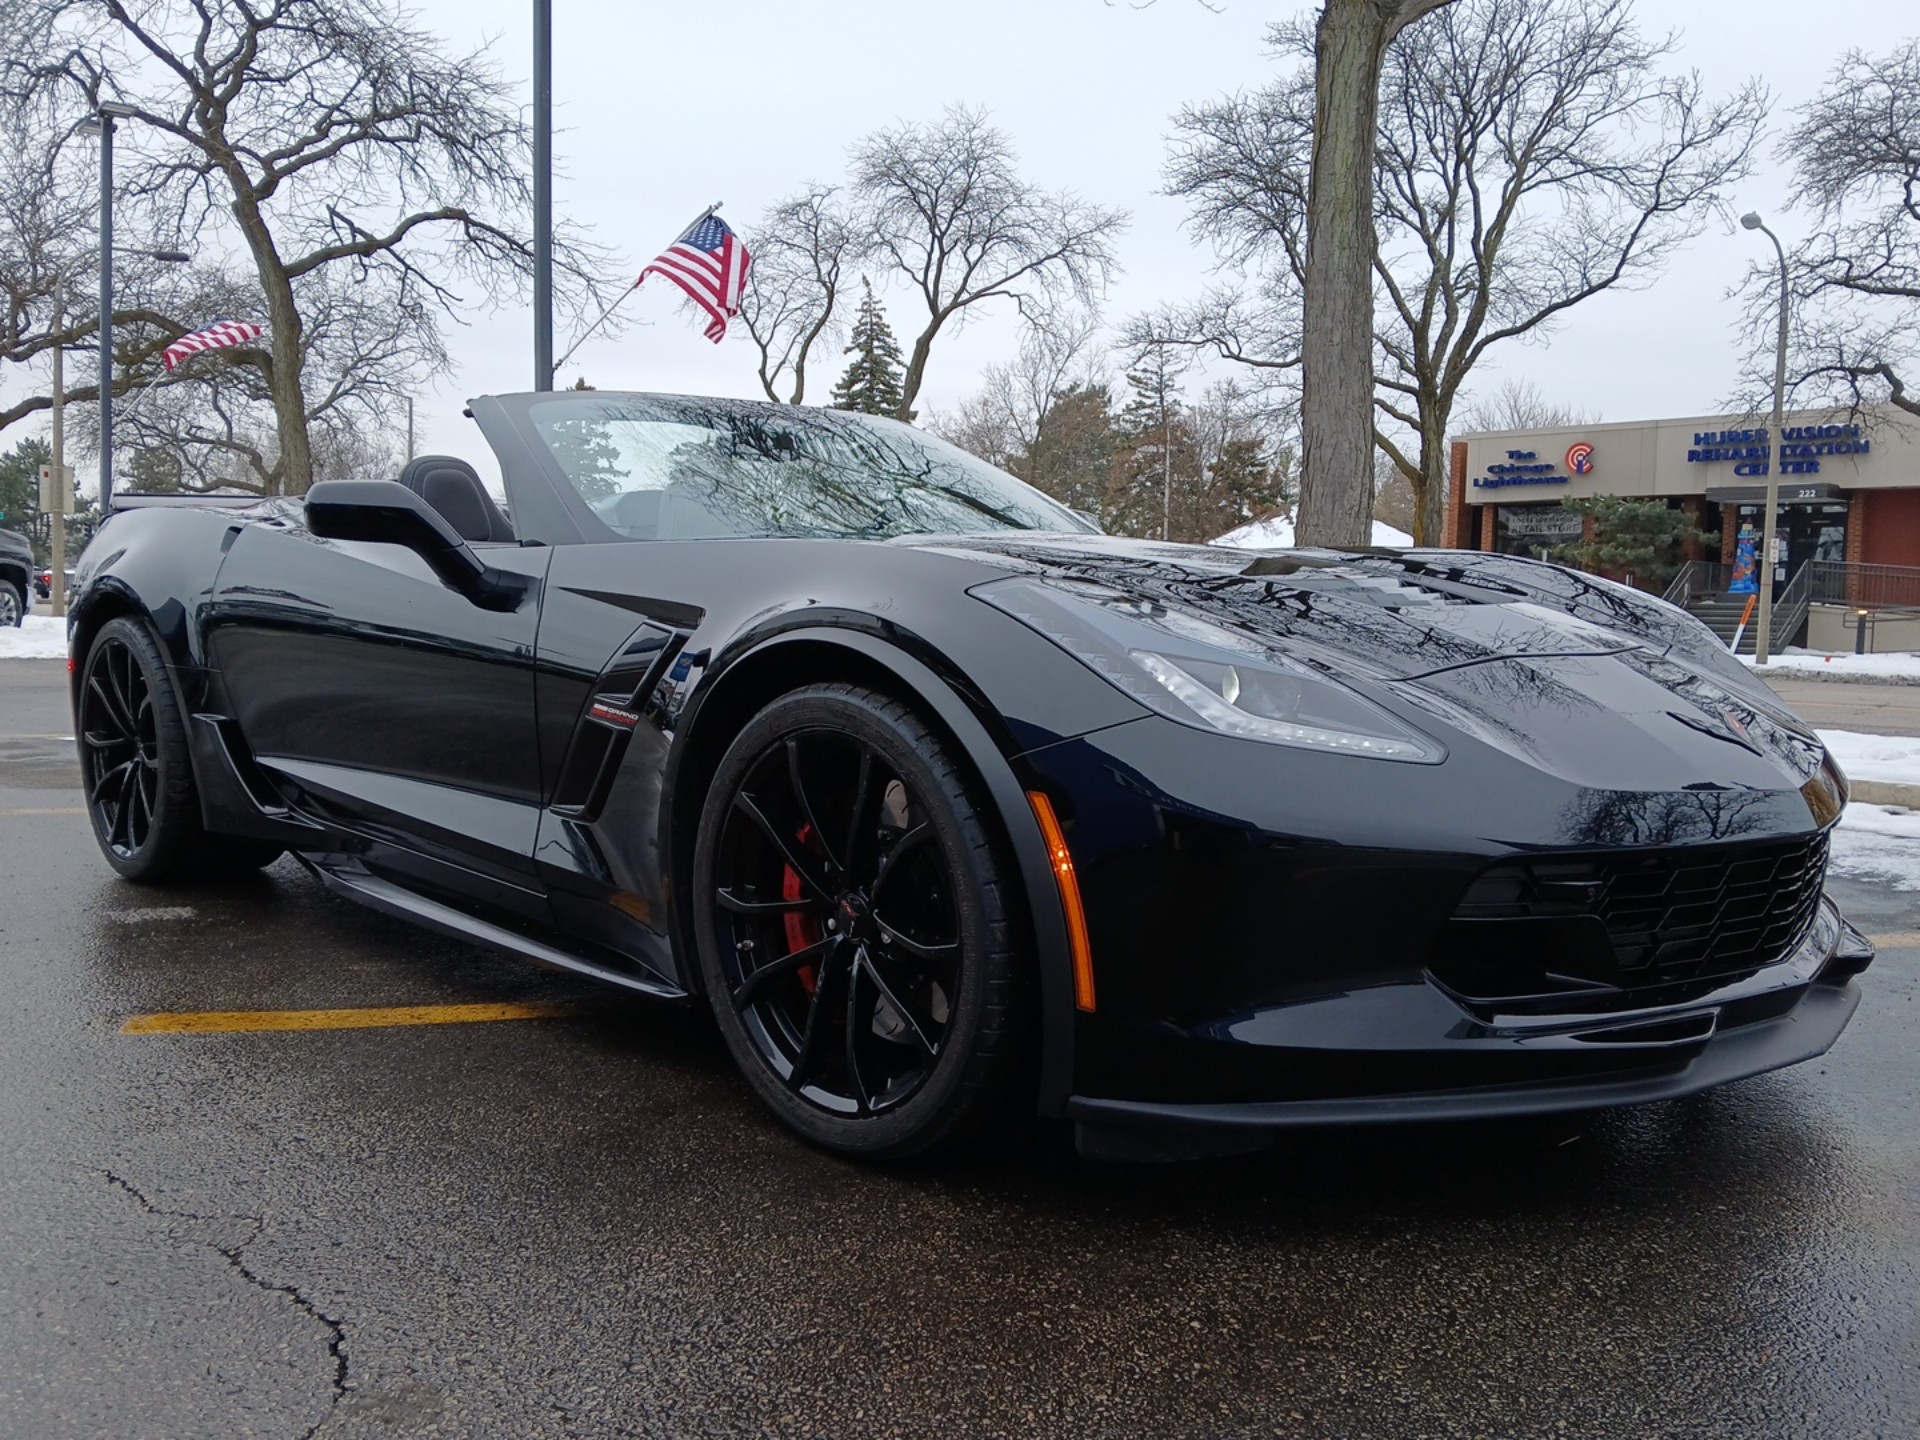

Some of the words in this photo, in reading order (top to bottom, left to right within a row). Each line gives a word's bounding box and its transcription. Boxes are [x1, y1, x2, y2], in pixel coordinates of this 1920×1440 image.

[1694, 428, 1769, 446] HUBER
[1781, 424, 1860, 441] VISION
[1505, 450, 1537, 461] The
[1687, 439, 1870, 463] REHABIITATION
[1487, 464, 1555, 474] Chicago
[1473, 476, 1569, 488] Lighthouse
[1799, 489, 1816, 498] 222
[608, 708, 638, 720] GRAND
